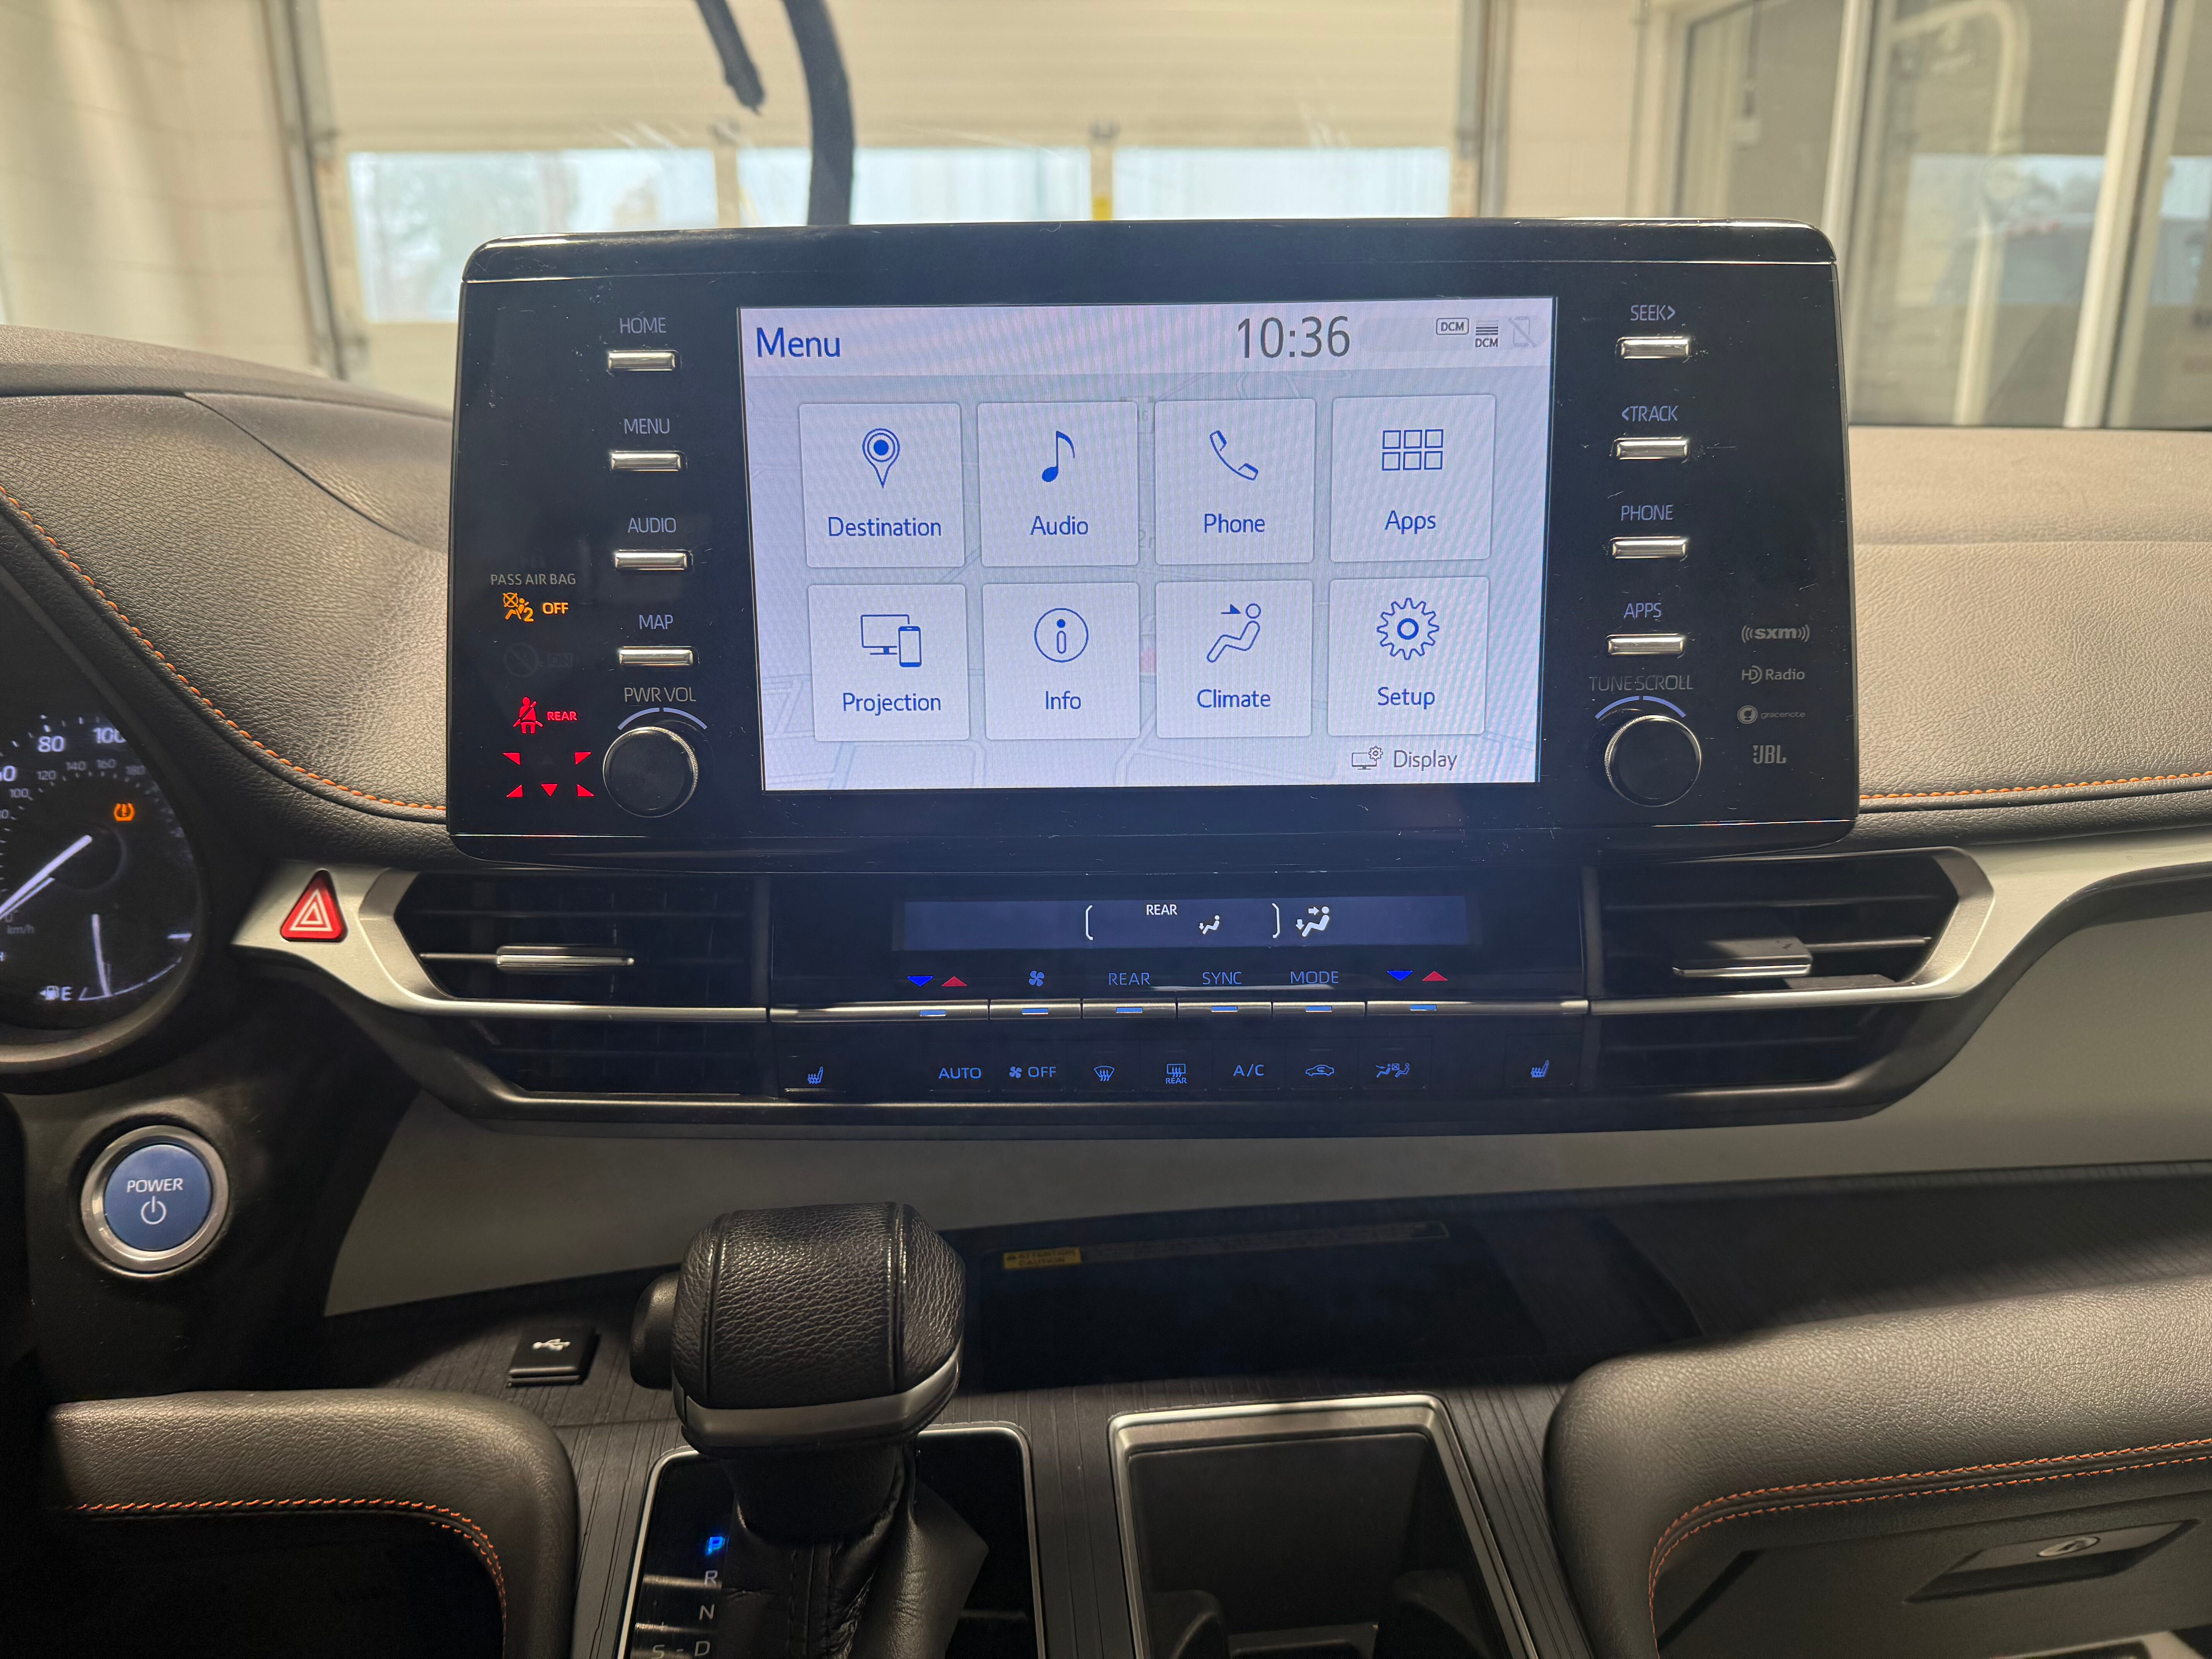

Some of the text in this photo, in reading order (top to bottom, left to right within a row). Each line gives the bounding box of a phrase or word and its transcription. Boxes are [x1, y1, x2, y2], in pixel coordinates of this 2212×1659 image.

[620, 317, 666, 333] HOME
[1441, 321, 1465, 331] DCM
[756, 327, 841, 358] Menu
[1237, 316, 1350, 360] 10:36
[1475, 338, 1498, 347] DCM
[624, 418, 670, 434] MENU
[1621, 505, 1673, 521] PHONE
[628, 517, 676, 533] AUDIO
[828, 517, 941, 536] Destination
[1030, 515, 1088, 535] Audio
[1204, 514, 1265, 533] Phone
[1384, 510, 1436, 535] Apps
[491, 574, 576, 585] PASS AIR BAG
[543, 602, 569, 615] OFF
[1624, 603, 1661, 618] APPS
[639, 615, 673, 630] MAP
[1765, 668, 1805, 680] Radio
[1589, 675, 1693, 691] TUNE SCROLL
[624, 687, 696, 702] PWR VOL
[1046, 690, 1081, 709] Info
[1197, 689, 1271, 708] Climate
[1377, 687, 1435, 711] Setup
[843, 692, 941, 716] Projection
[547, 711, 577, 721] REAR
[38, 736, 65, 752] 80
[1393, 749, 1458, 771] Display
[1753, 745, 1786, 764] JBL
[66, 761, 86, 771] 140
[97, 759, 116, 769] 160
[0, 766, 17, 782] 0
[38, 770, 56, 780] 120
[10, 788, 29, 798] 100
[1146, 904, 1177, 915] REAR
[7, 924, 34, 934] km/h
[1109, 972, 1150, 985] REAR
[1202, 972, 1242, 985] SYNC
[1290, 971, 1338, 984] MODE
[61, 986, 72, 1001] E
[939, 1068, 981, 1079] AUTO
[1028, 1066, 1056, 1078] OFF
[1233, 1064, 1264, 1077] A/C
[127, 1178, 183, 1193] POWER
[707, 1536, 724, 1555] P
[704, 1570, 718, 1585] R
[699, 1604, 714, 1620] N
[694, 1641, 710, 1656] D
